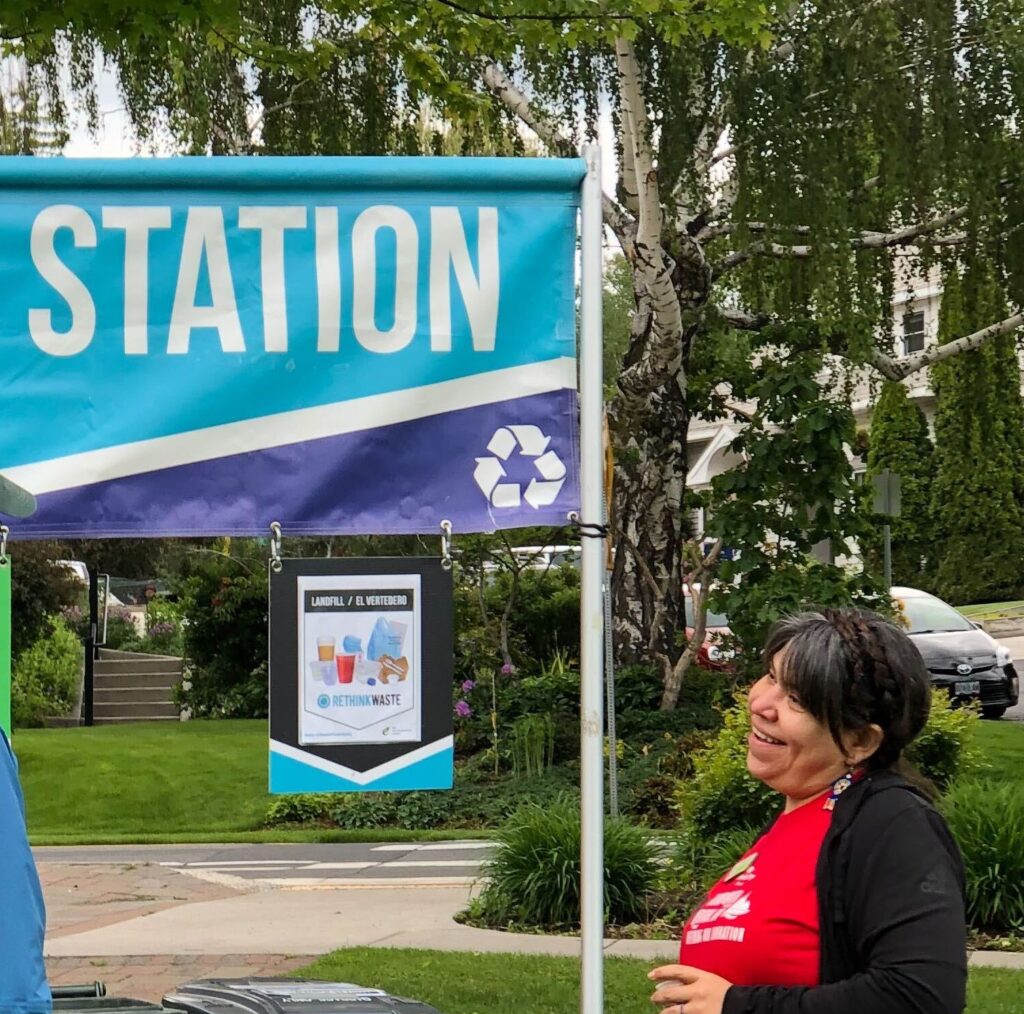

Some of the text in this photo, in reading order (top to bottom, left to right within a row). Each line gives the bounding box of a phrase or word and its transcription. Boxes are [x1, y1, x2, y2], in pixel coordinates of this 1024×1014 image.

[27, 204, 502, 357] STATION
[311, 595, 345, 607] LANDFILL
[356, 596, 365, 606] EL
[366, 595, 407, 606] VERTEDERO
